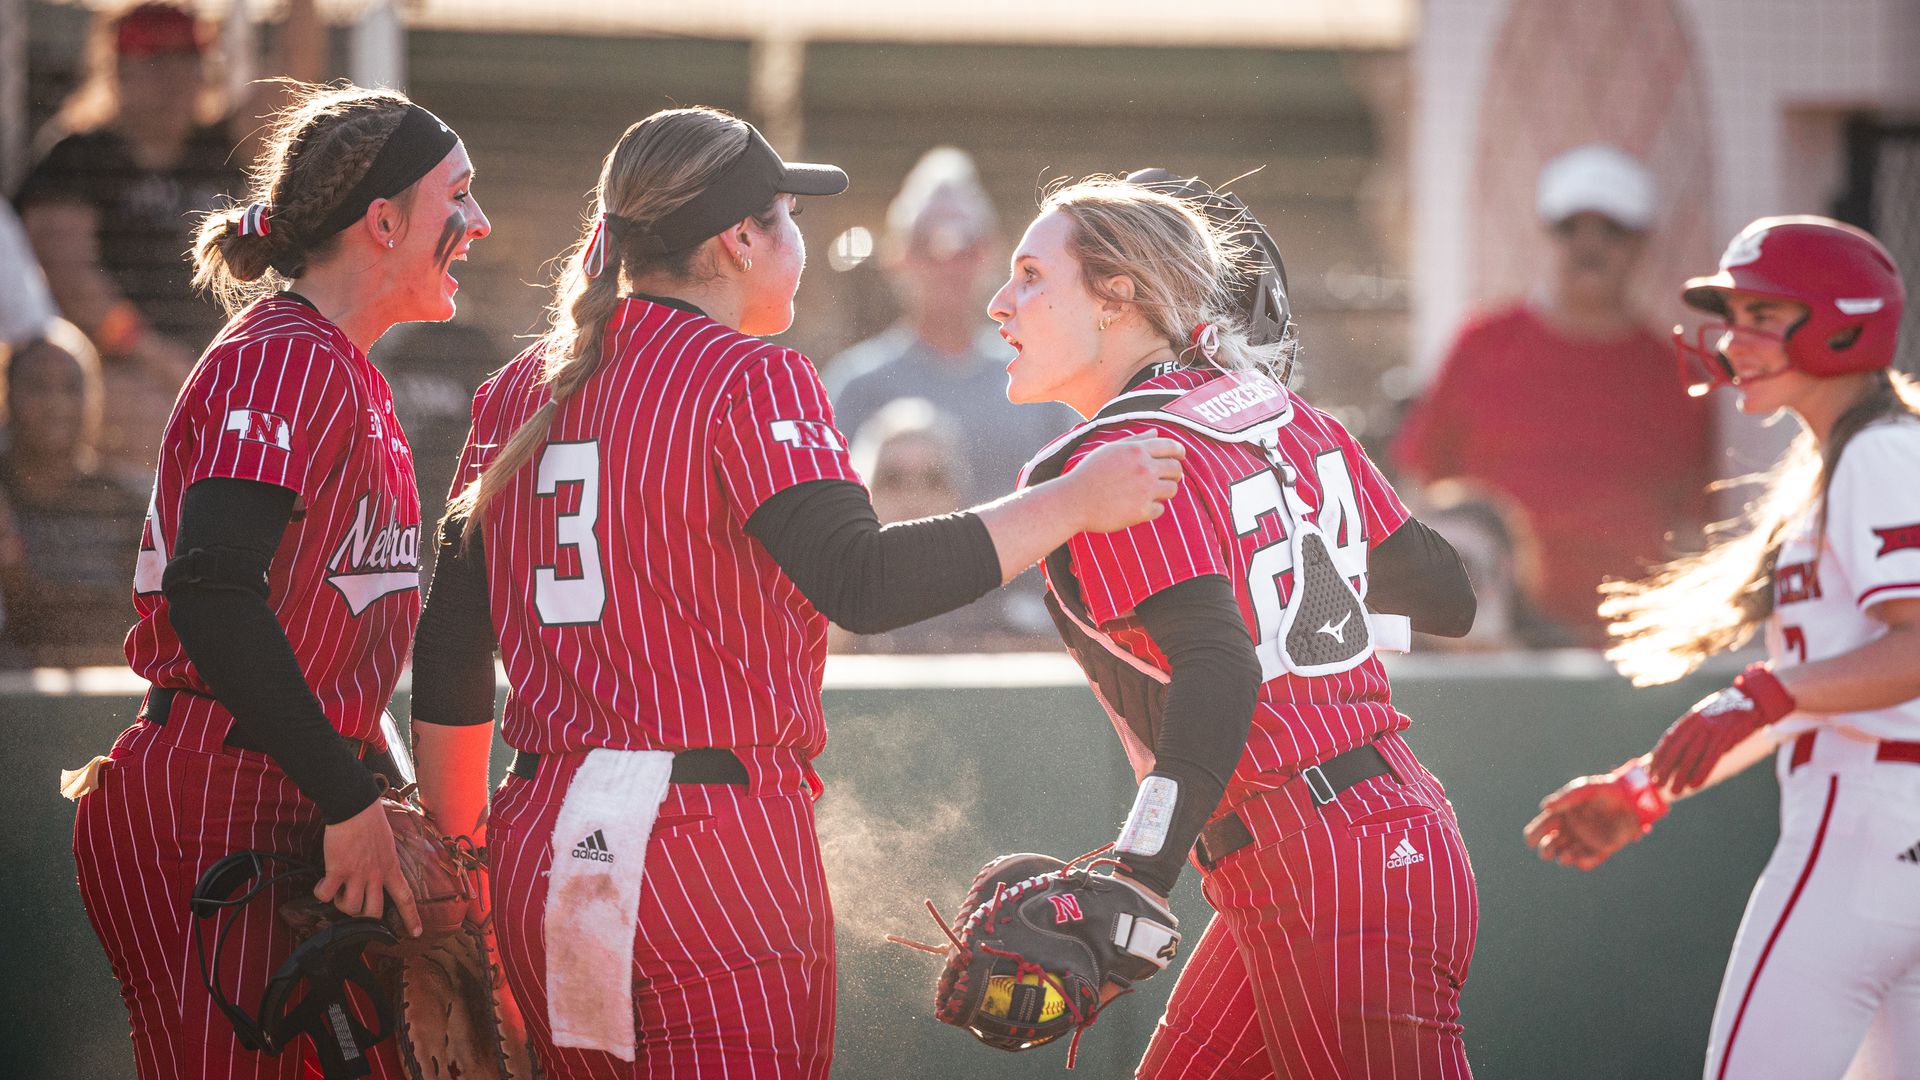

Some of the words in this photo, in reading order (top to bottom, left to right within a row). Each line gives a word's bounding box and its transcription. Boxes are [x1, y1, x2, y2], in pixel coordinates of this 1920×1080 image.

[1191, 379, 1279, 423] HUSKERS
[246, 410, 283, 446] N
[794, 420, 832, 449] N
[535, 439, 607, 627] 3
[1229, 446, 1369, 648] 24
[571, 848, 615, 864] adidas
[1387, 853, 1424, 869] adidas
[1048, 893, 1084, 924] N
